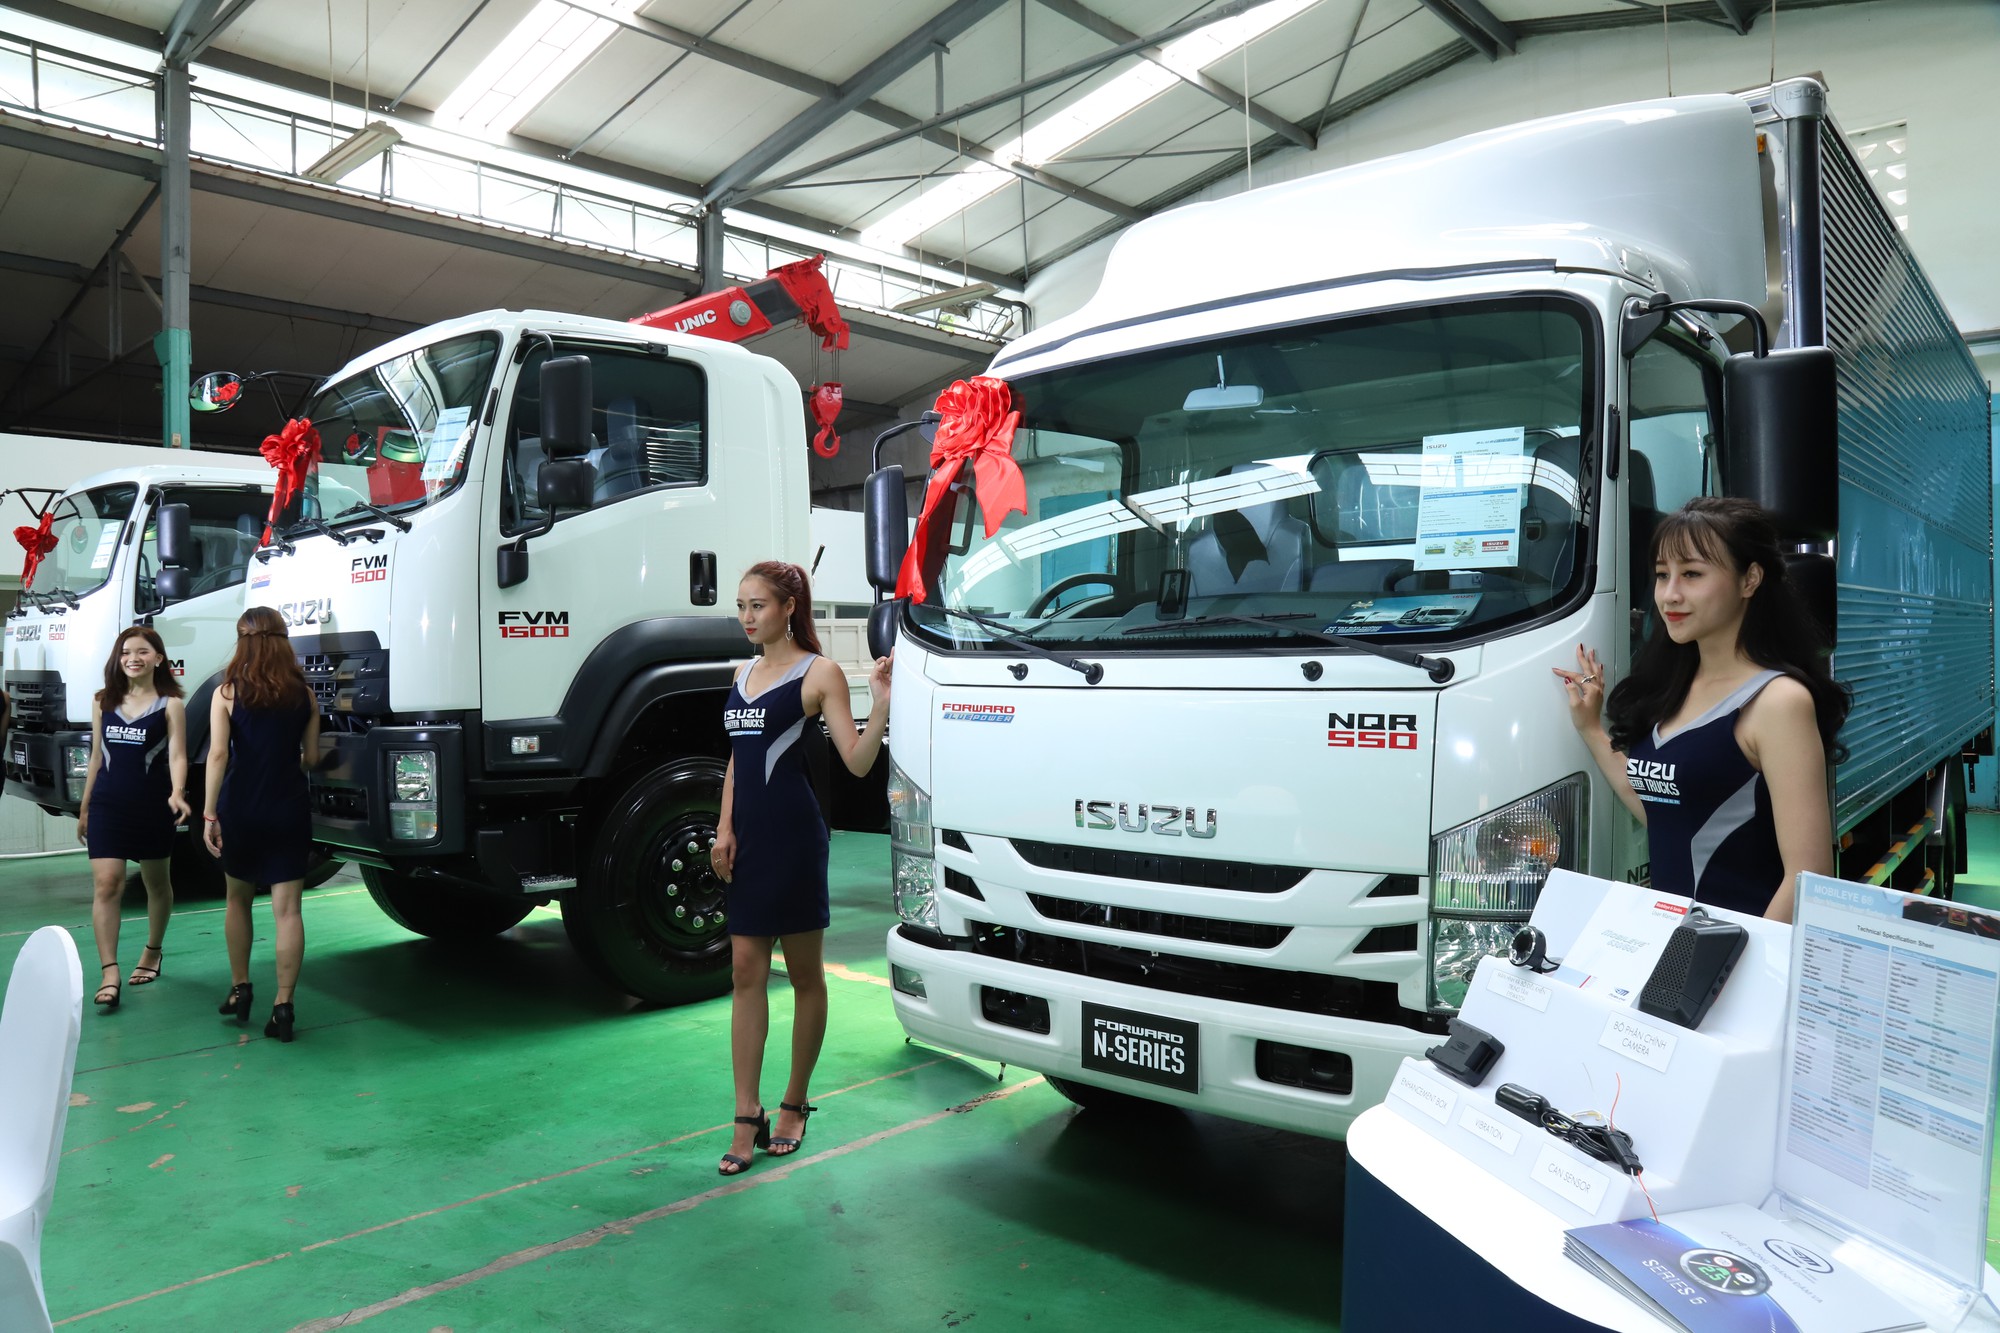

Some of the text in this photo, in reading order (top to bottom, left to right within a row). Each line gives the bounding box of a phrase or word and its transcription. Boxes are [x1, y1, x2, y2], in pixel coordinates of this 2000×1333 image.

[675, 309, 717, 333] UNIC
[352, 554, 388, 571] FVM
[351, 569, 386, 584] 1500
[499, 611, 568, 625] FVM
[49, 632, 64, 640] 1500
[50, 624, 66, 635] FVM
[499, 626, 569, 638] 1500
[724, 708, 766, 720] ISUZU
[942, 703, 1015, 714] FORWARD
[106, 725, 146, 736] ISUZU
[741, 719, 764, 728] TRUCKS
[1328, 713, 1418, 731] NQR
[1328, 730, 1418, 750] 550
[1626, 758, 1675, 781] SUZU
[1644, 778, 1680, 796] TRUCKS
[1074, 798, 1217, 839] ISUZU
[1627, 863, 1650, 883] NQ
[1814, 884, 1860, 904] MOBILEYE
[1857, 924, 1934, 949] Technical Specification Sheet
[1094, 1018, 1184, 1044] FORWARD
[1094, 1030, 1185, 1075] N-SERIES
[1622, 1038, 1650, 1056] CAMERA
[1400, 1077, 1448, 1110] ENHANCEMENT BOX
[1475, 1118, 1504, 1140] VIBRATION
[1548, 1162, 1591, 1194] CAN SENSOR
[1642, 1259, 1696, 1296] SERIES
